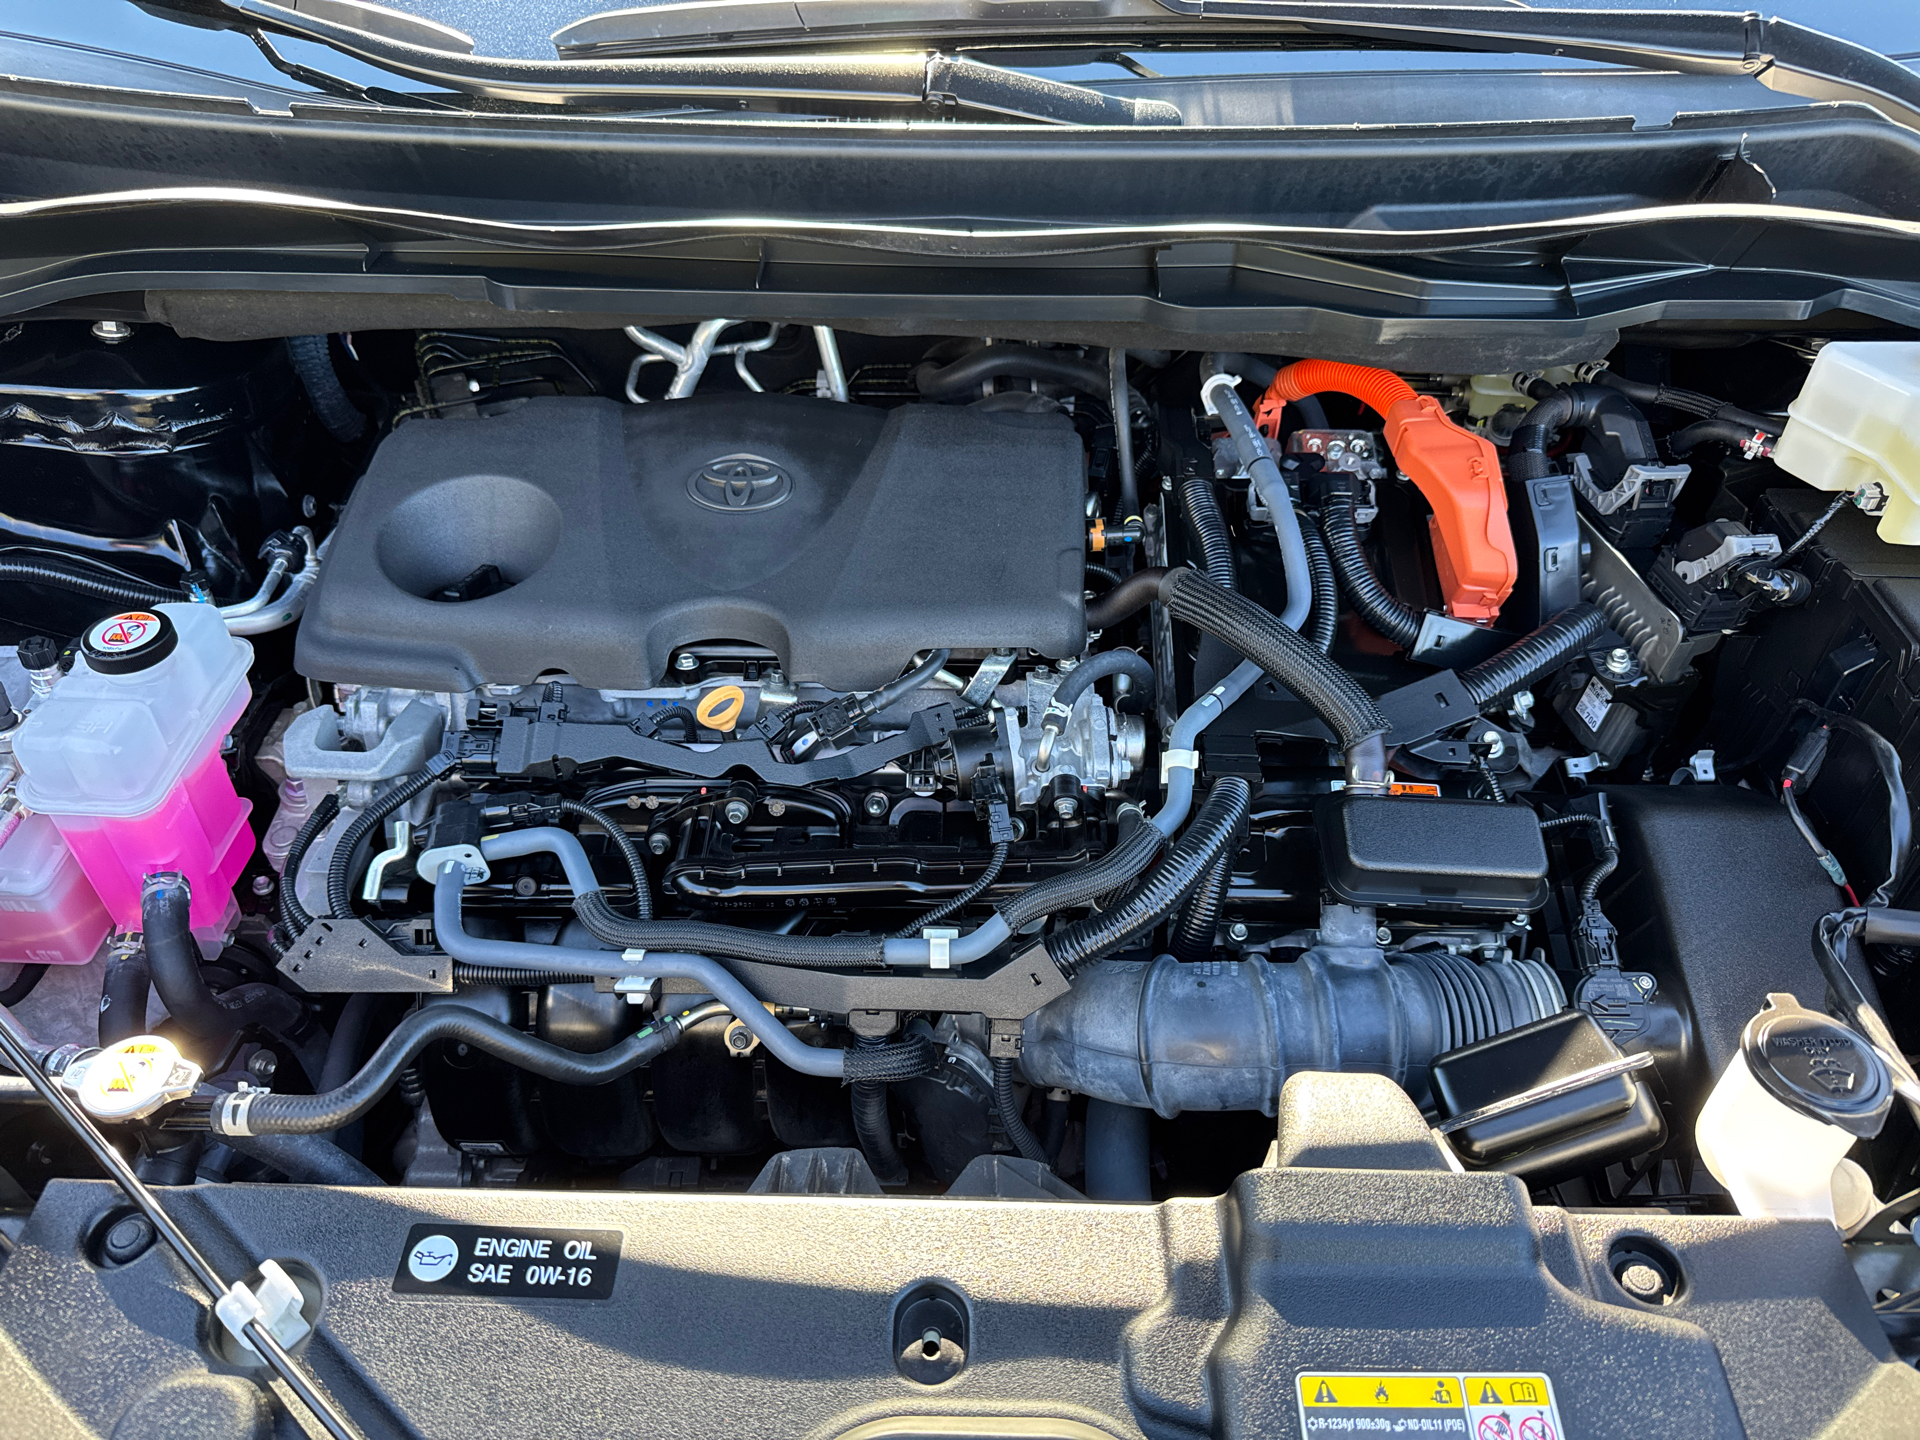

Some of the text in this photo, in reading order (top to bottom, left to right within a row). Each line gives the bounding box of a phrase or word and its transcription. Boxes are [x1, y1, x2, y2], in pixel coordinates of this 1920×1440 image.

[1585, 711, 1597, 728] 700
[0, 900, 36, 912] ULL
[1771, 1037, 1817, 1047] WASHER
[473, 1237, 597, 1260] ENGINE OIL
[467, 1263, 593, 1287] SAE 0W-16
[1318, 1418, 1466, 1433] R-1234yf 900±30g ND-OIL11 (POE)
